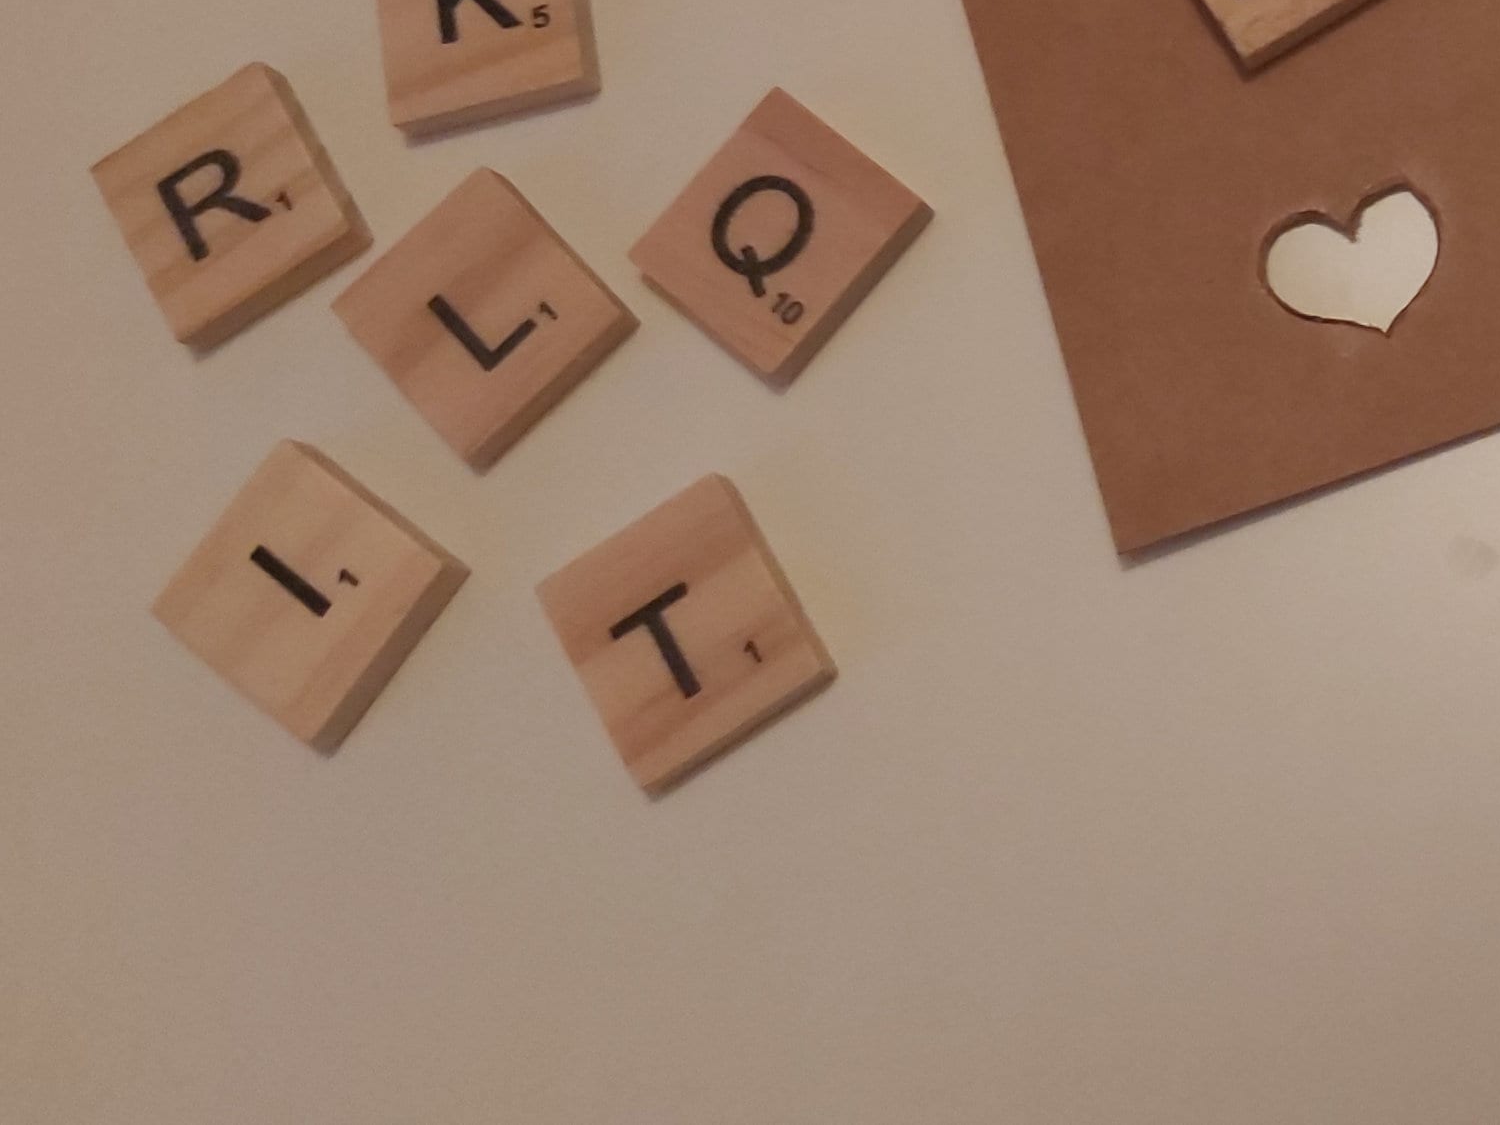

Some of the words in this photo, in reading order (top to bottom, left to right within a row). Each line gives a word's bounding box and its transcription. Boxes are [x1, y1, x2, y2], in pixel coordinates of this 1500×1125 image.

[532, 4, 551, 29] 5
[156, 148, 273, 263] R
[274, 191, 293, 211] 1
[710, 174, 815, 300] Q
[771, 292, 805, 326] 10
[426, 293, 538, 372] L
[538, 301, 558, 321] 1
[249, 544, 332, 618] I
[338, 568, 360, 588] 1
[608, 581, 703, 700] T
[742, 639, 763, 664] 1
